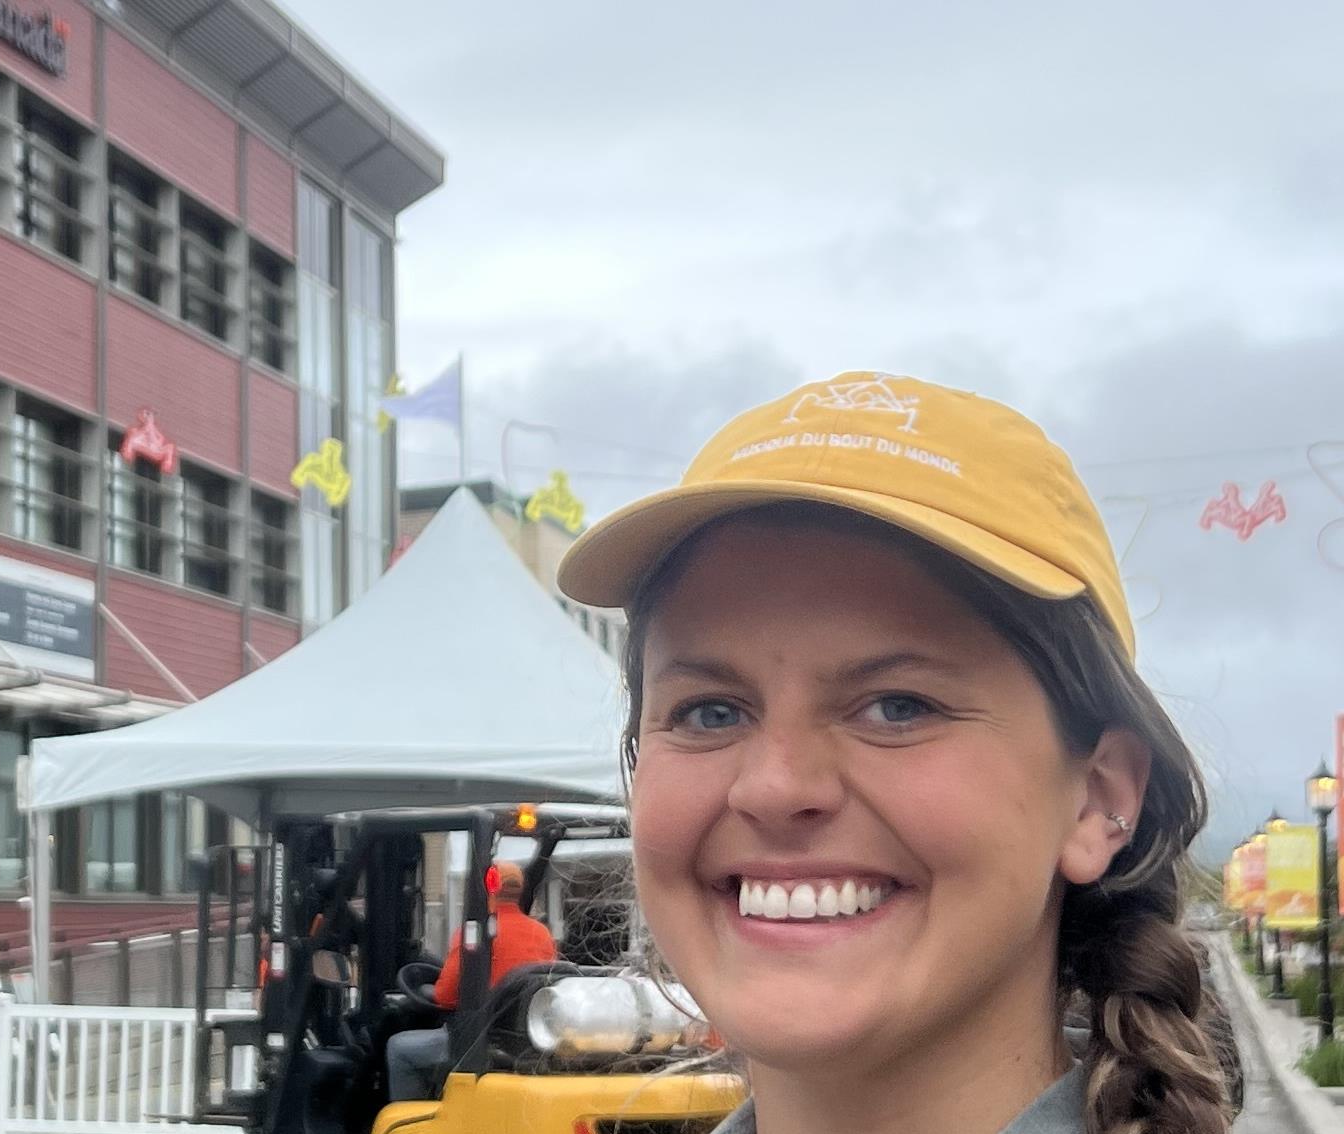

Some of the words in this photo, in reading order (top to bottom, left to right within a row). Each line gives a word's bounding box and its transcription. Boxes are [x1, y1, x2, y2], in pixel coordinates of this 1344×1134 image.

[731, 433, 798, 460] MUSIQUE
[800, 432, 826, 447] DU
[828, 433, 873, 449] BOUT
[876, 437, 901, 456] DU
[904, 446, 962, 477] MONDE
